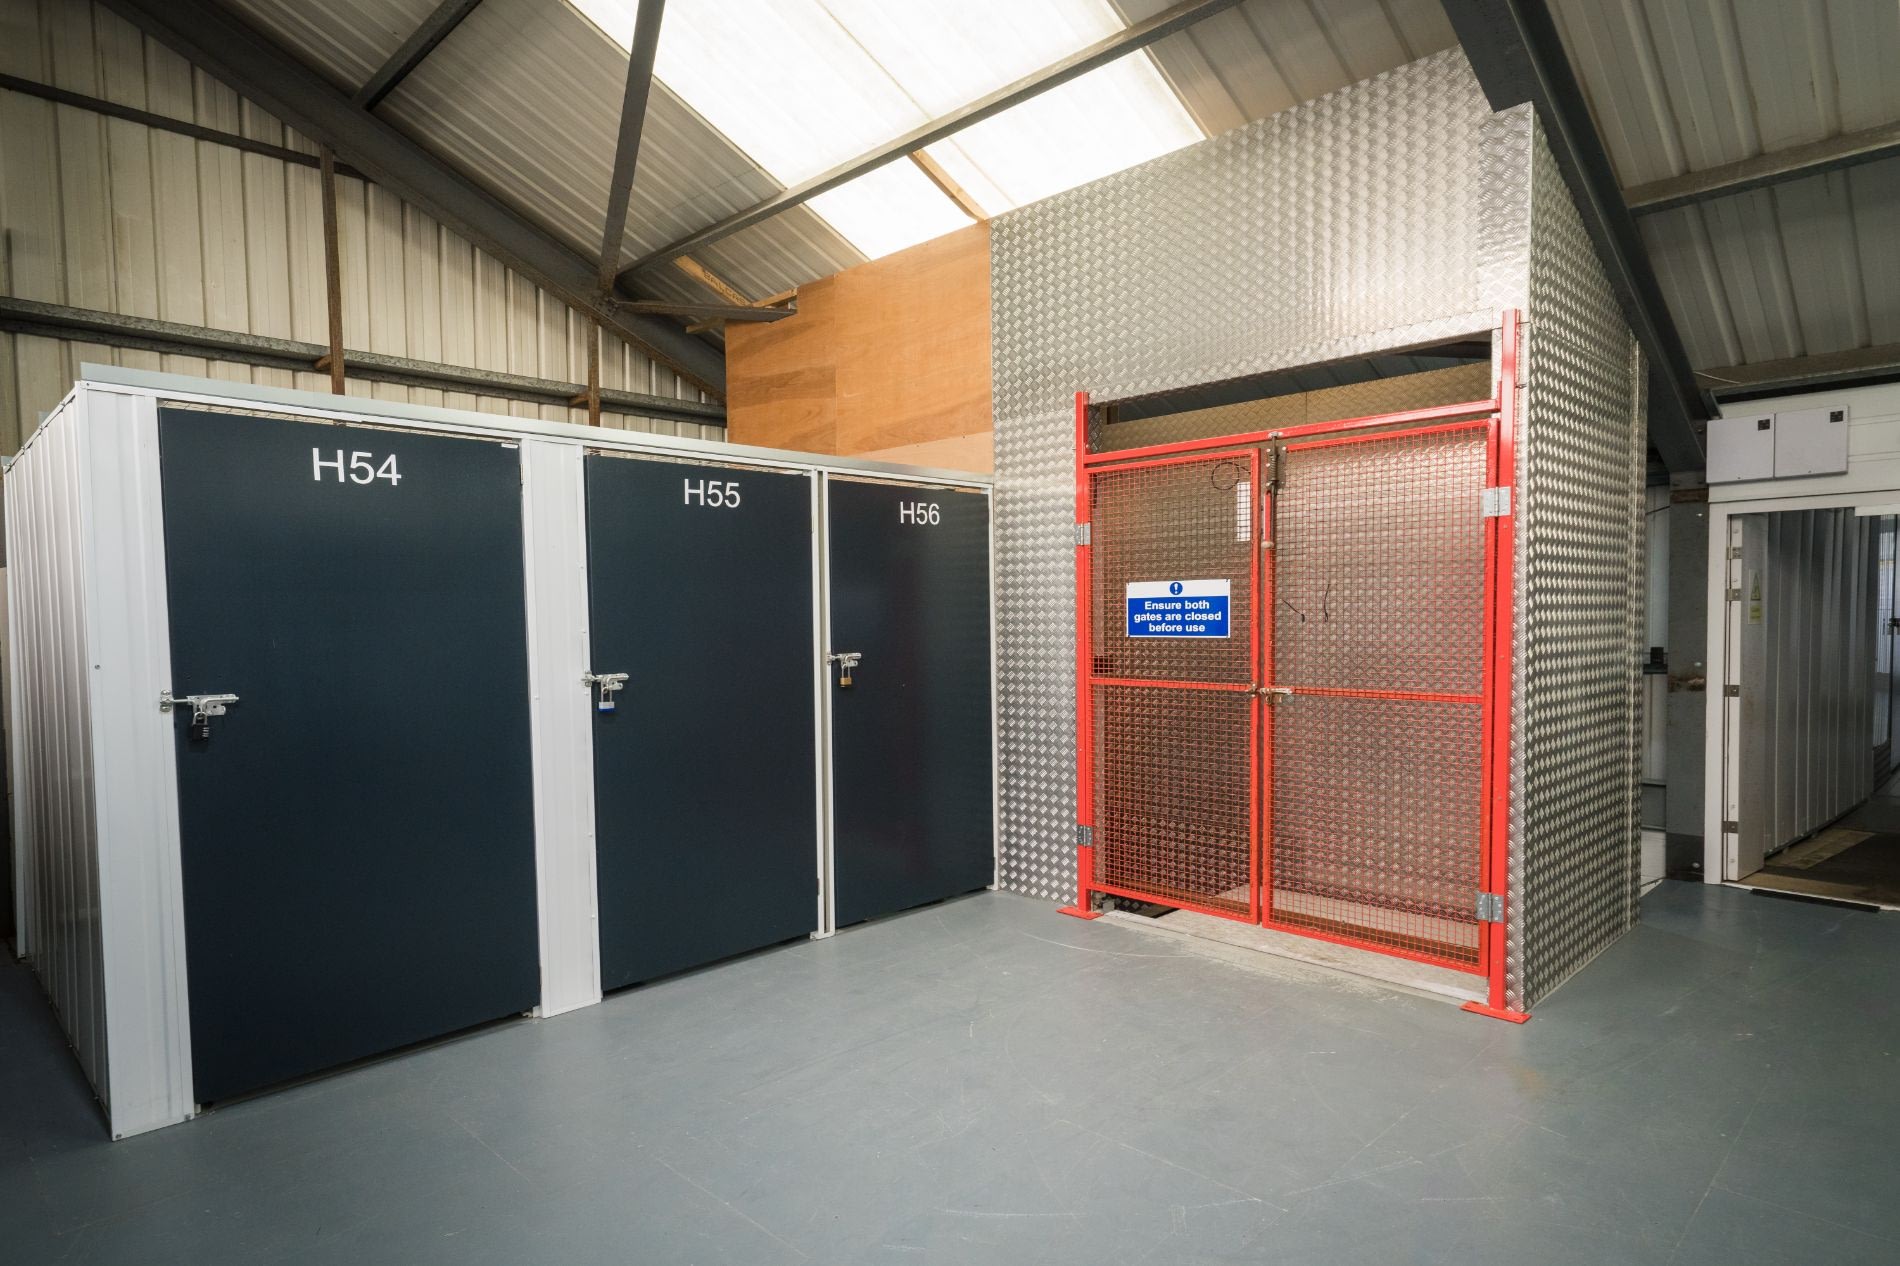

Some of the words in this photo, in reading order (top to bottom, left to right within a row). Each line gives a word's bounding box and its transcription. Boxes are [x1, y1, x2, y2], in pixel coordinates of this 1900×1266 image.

[311, 447, 403, 486] H54
[683, 478, 742, 509] H55
[898, 501, 941, 526] H56
[1144, 601, 1182, 610] Ensure
[1184, 600, 1210, 610] both
[1134, 612, 1162, 623] gates
[1184, 611, 1222, 621] closed
[1148, 623, 1183, 632] before
[1185, 624, 1206, 632] use
